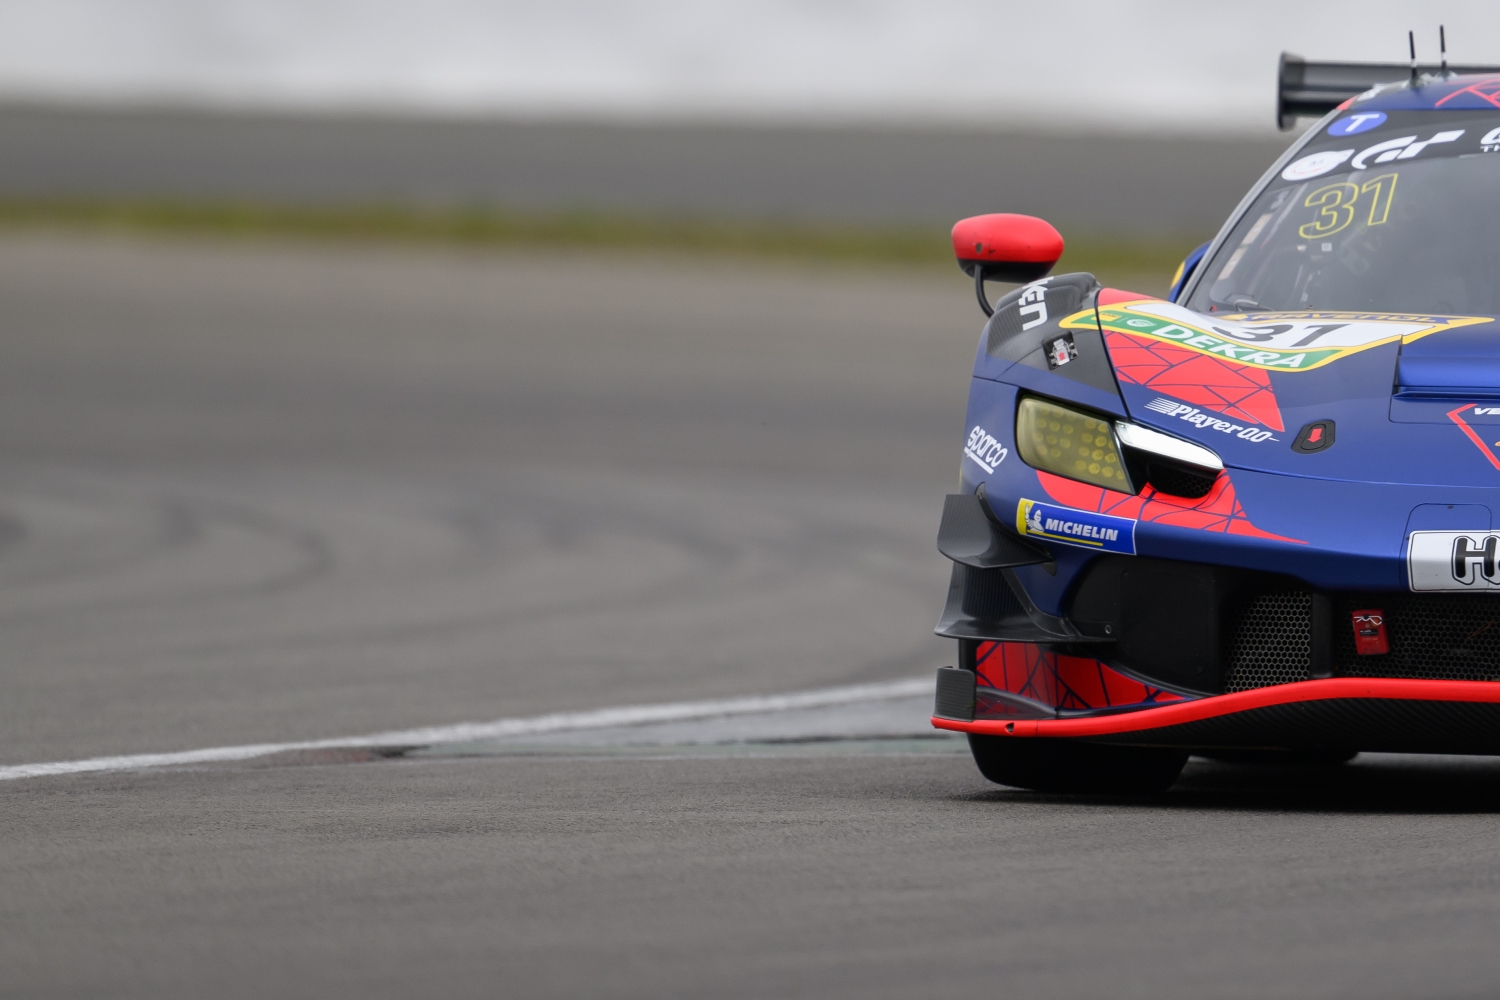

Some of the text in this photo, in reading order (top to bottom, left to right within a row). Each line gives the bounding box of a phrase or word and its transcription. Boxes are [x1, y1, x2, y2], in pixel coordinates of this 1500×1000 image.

[1345, 114, 1379, 133] T
[1299, 172, 1399, 240] 31
[1151, 323, 1308, 368] DEKRA
[1211, 323, 1353, 348] 31
[1167, 404, 1243, 434] Player
[966, 425, 1009, 470] sparco
[1045, 517, 1119, 541] MICHELIN
